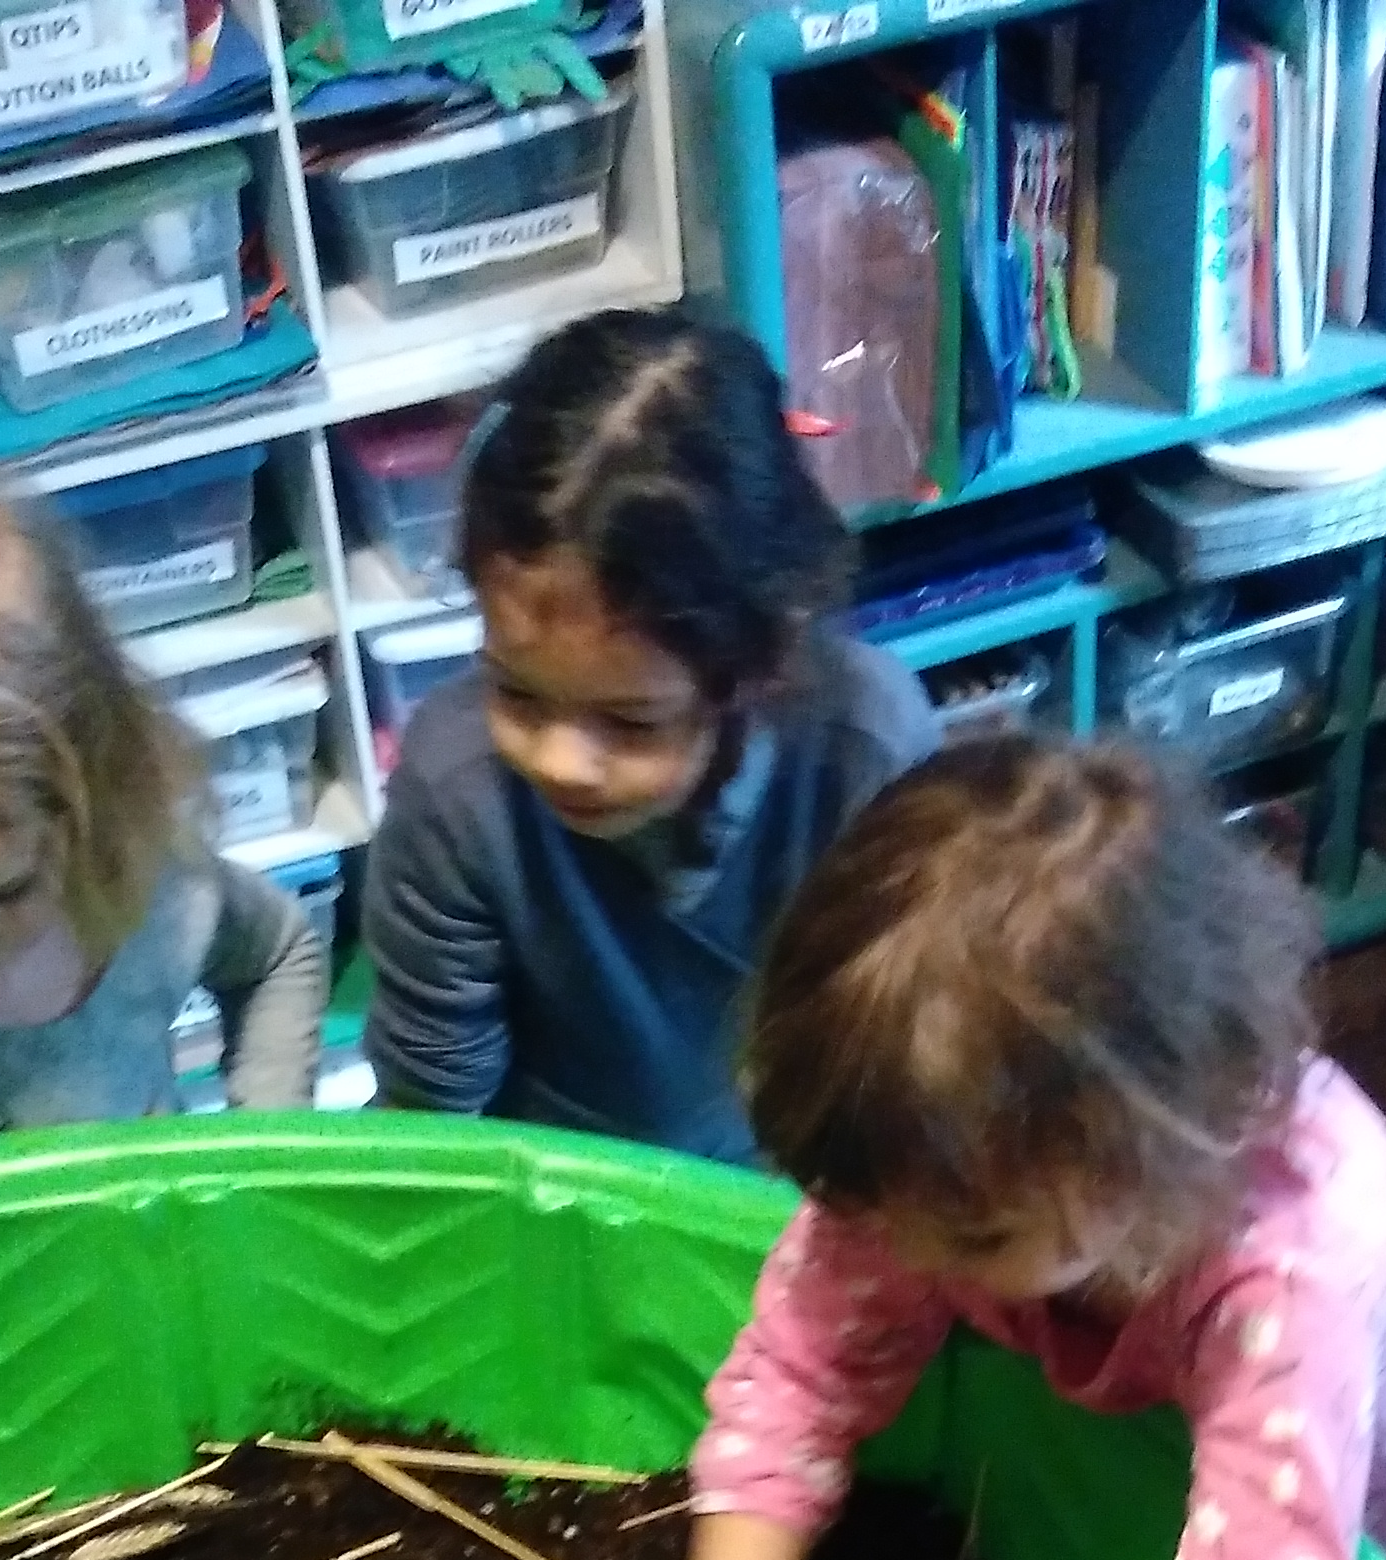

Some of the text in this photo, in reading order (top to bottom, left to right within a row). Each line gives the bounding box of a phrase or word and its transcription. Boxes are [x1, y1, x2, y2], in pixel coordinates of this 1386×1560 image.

[9, 14, 81, 48] QTIPS
[81, 57, 152, 93] BALLS
[420, 236, 480, 265] PAINT
[45, 299, 194, 357] CLOTHESPINS
